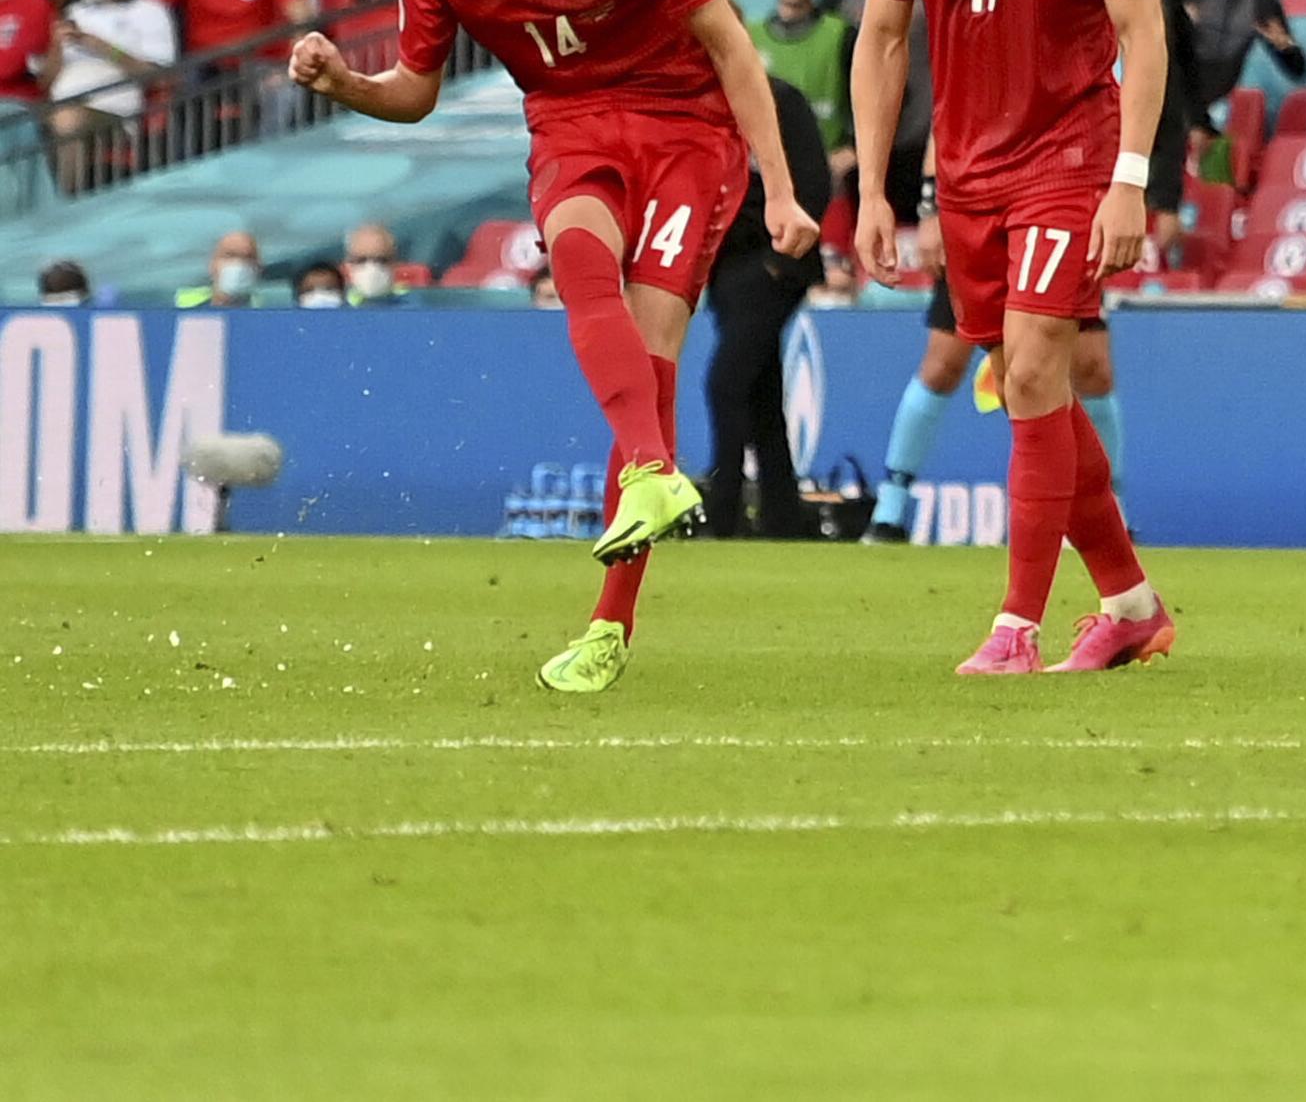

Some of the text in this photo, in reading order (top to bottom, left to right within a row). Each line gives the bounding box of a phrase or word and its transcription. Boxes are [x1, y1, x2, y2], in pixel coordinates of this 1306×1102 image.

[523, 15, 587, 68] 14
[632, 199, 691, 268] 14
[1017, 226, 1071, 294] 17
